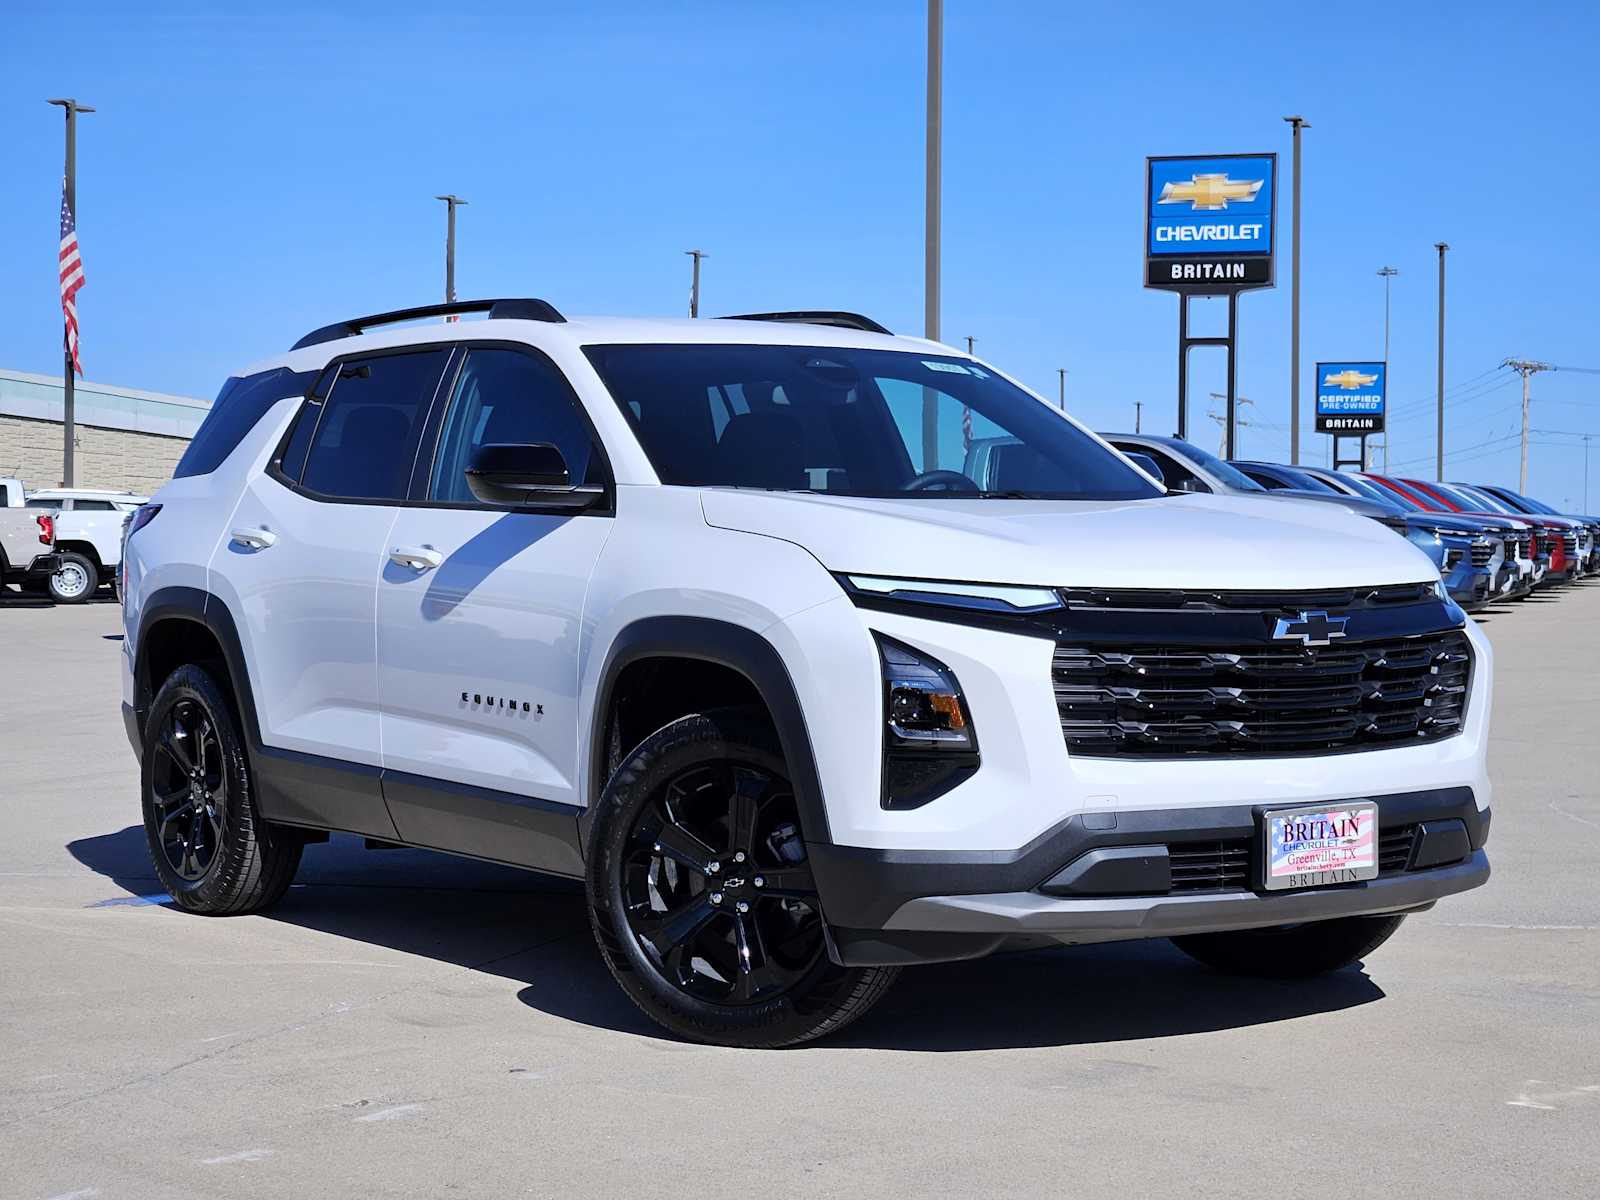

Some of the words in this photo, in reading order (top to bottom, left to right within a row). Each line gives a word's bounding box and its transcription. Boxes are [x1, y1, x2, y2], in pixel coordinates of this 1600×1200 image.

[1156, 224, 1263, 241] CHEVROLET
[1171, 263, 1245, 279] BRITAIN
[1319, 394, 1381, 403] CERTIFIED
[1322, 402, 1377, 410] PRE-OWNED
[1325, 418, 1374, 429] BRITAIN
[461, 692, 545, 715] EQUINOX
[1283, 817, 1360, 843] BRITAIN
[1282, 839, 1339, 852] CHEVROLET
[1287, 849, 1340, 866] Greenville,
[1342, 848, 1357, 860] TX
[1289, 869, 1358, 887] BRITAIN
